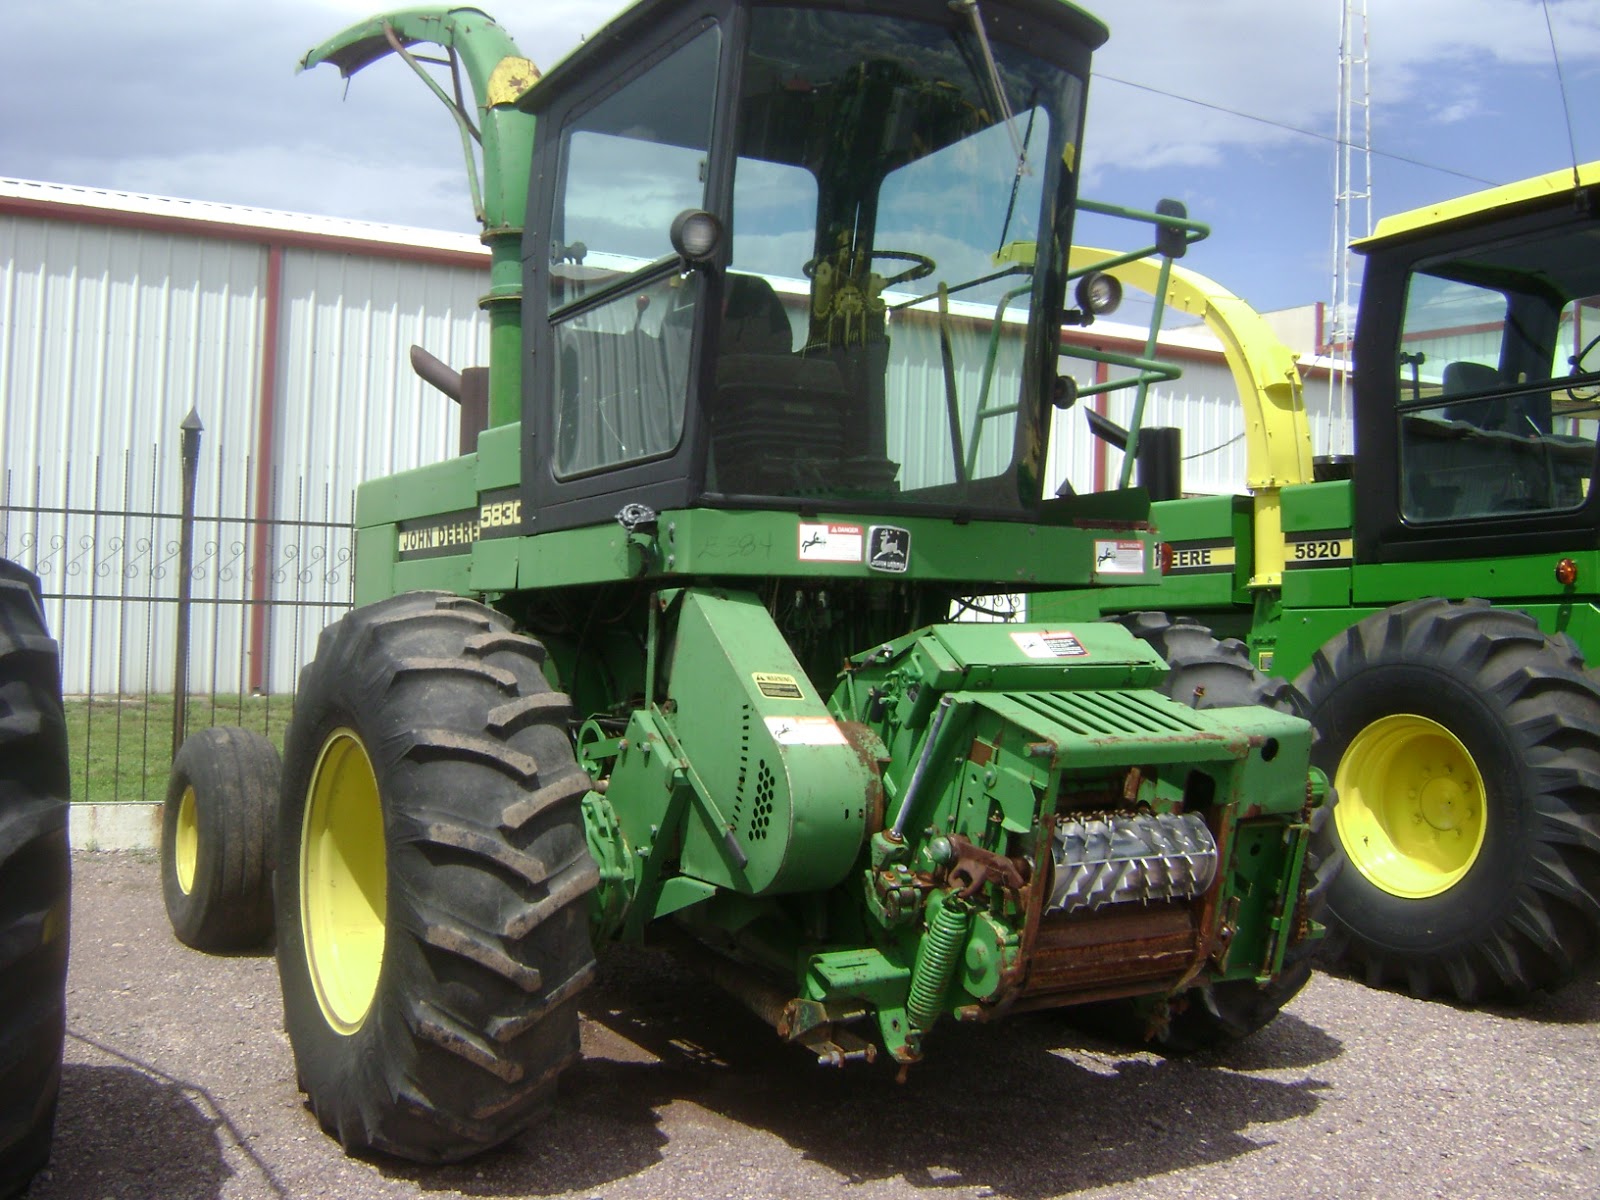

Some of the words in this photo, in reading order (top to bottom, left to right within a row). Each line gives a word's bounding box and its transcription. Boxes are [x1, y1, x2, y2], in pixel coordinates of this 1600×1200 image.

[403, 527, 432, 550] JOHN
[439, 521, 480, 546] DEERE
[1171, 549, 1211, 567] EERE
[1295, 541, 1341, 559] 5820
